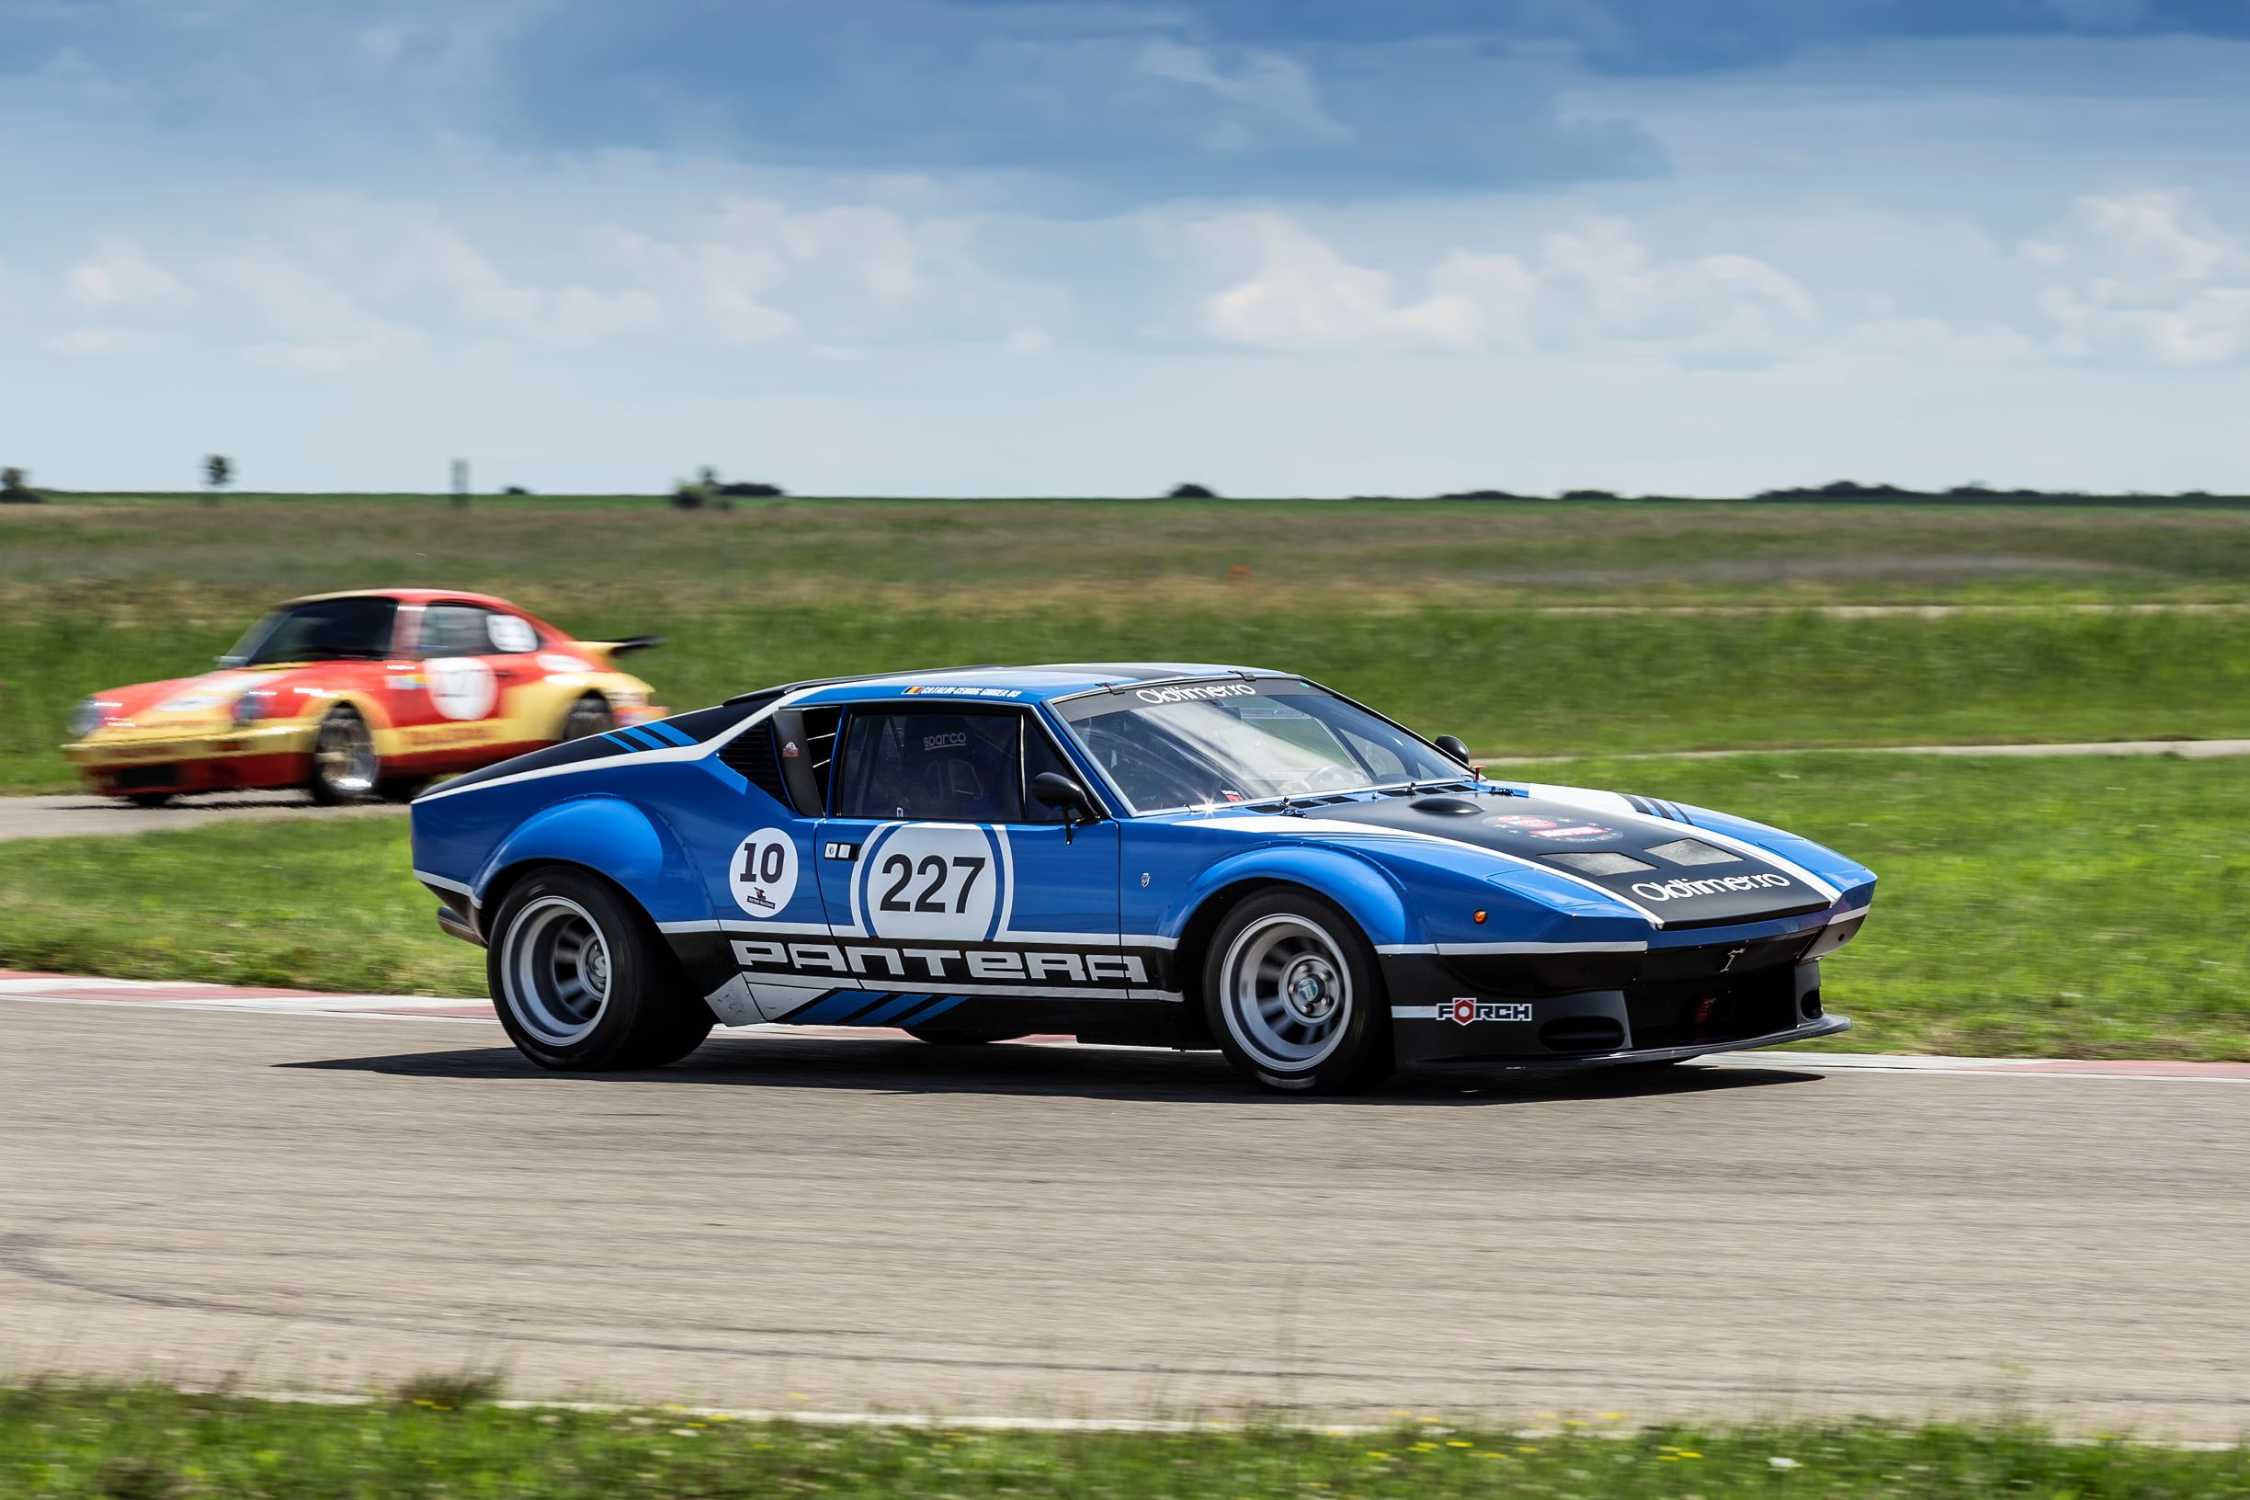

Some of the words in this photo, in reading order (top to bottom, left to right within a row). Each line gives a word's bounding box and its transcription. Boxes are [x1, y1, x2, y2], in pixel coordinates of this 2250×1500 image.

[1136, 684, 1257, 704] Oldtimer.ro
[740, 842, 785, 884] 10
[880, 854, 985, 914] 227
[1631, 873, 1791, 902] Oldtimer.ro
[730, 939, 1149, 983] PANTERA
